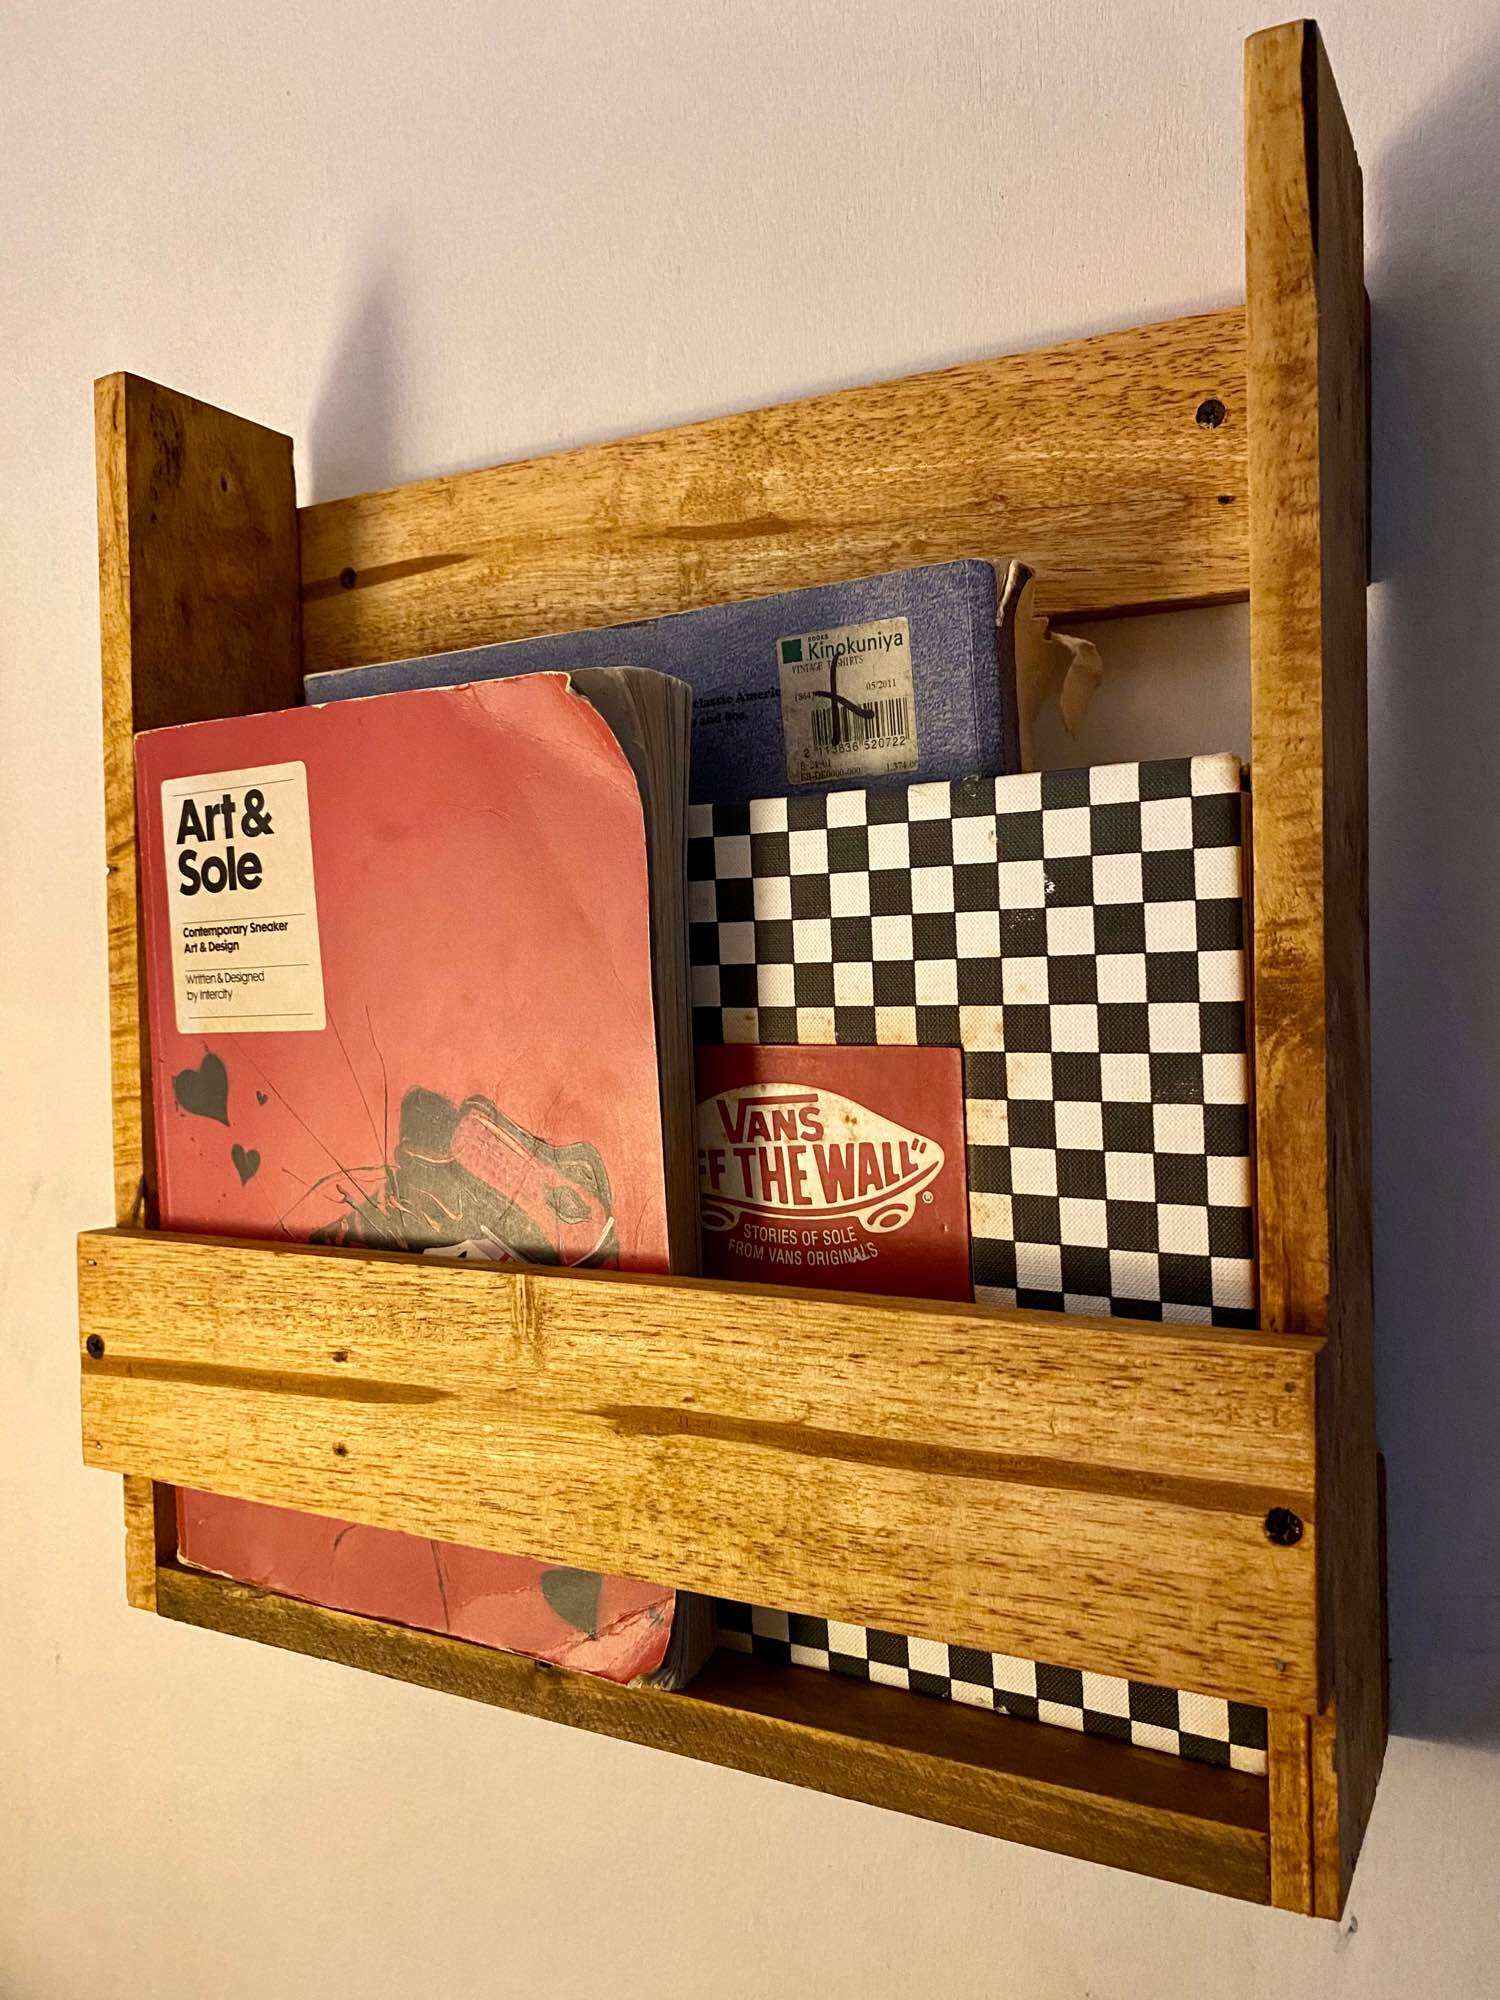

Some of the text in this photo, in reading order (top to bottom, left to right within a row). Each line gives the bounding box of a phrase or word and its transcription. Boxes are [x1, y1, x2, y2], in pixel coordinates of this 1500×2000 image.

[808, 631, 903, 660] Kinokuniya
[792, 662, 823, 674] VINTAGE
[865, 679, 897, 690] 05/2011
[803, 748, 810, 758] 2
[864, 736, 906, 750] 520722
[176, 789, 275, 845] Art &
[178, 846, 263, 896] Sole
[183, 921, 289, 938] Contemporary Sneaker
[184, 940, 240, 953] Art & Design
[186, 971, 265, 985] Written & Designed
[187, 988, 233, 1003] by Intercity
[716, 1093, 824, 1144] VANS
[733, 1143, 812, 1206] THE
[744, 1223, 858, 1246] STORIES OF SOLE
[728, 1239, 879, 1266] FROM VANS ORIGINALS
